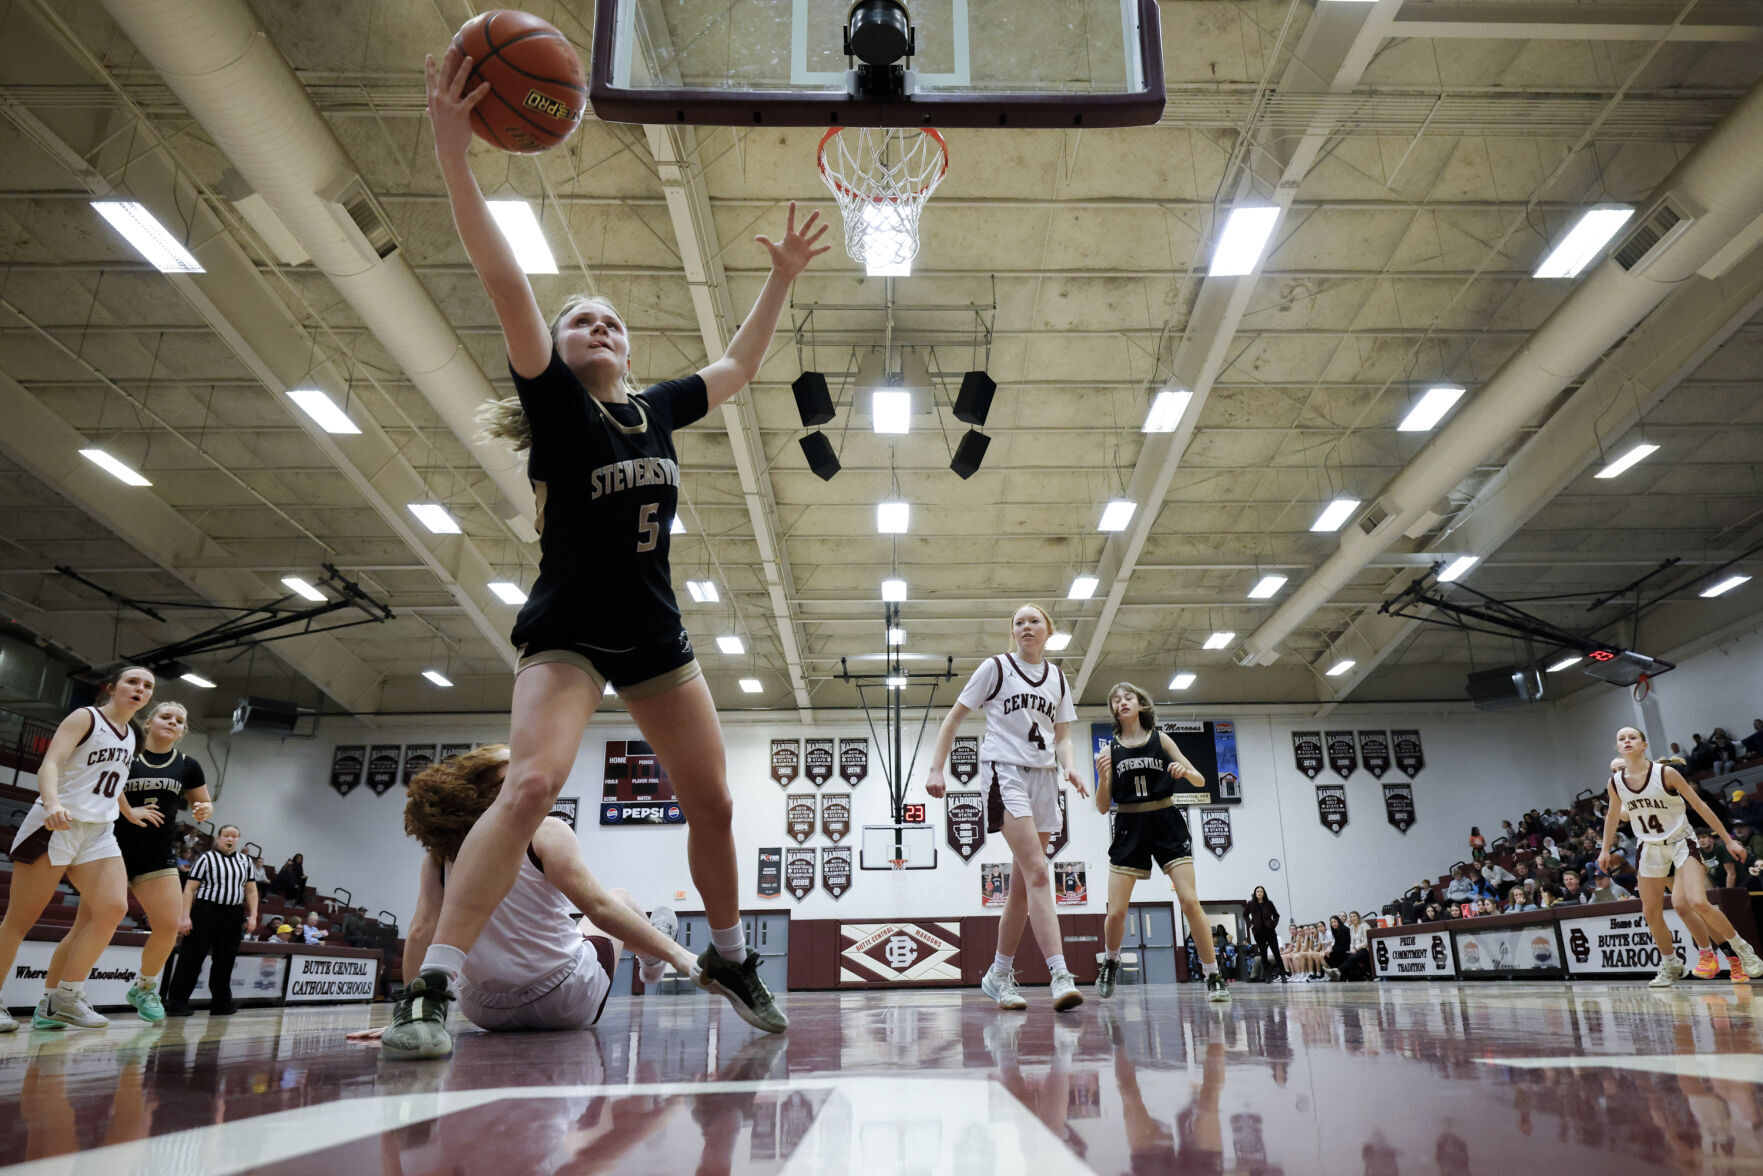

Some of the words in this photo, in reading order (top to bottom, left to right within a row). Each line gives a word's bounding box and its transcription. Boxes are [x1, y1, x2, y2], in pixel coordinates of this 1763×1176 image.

[591, 457, 678, 500] STEVENSVI
[636, 502, 660, 552] 5
[1164, 722, 1201, 731] Maroons
[1028, 721, 1046, 750] 4
[87, 747, 132, 767] CENTRA
[1116, 757, 1164, 777] STEVENSVILLE
[92, 770, 120, 798] 10
[1134, 776, 1148, 796] 11
[552, 804, 576, 819] ROONS
[948, 797, 982, 812] MAROONS
[1628, 798, 1668, 812] ENTRAL
[622, 808, 664, 818] PEPSI
[906, 806, 923, 820] 23
[1638, 815, 1665, 833] 14
[1610, 918, 1632, 929] Home
[1634, 915, 1642, 927] of
[856, 941, 872, 952] BUTTE
[872, 927, 894, 942] CENTRAL
[914, 930, 942, 948] MAROONS
[1400, 936, 1416, 946] PRIDE
[1598, 933, 1630, 947] BUTTE
[1632, 930, 1682, 946] CENL
[1393, 949, 1428, 959] COMMITMENT
[1601, 946, 1687, 968] MAROOS
[16, 966, 48, 979] Where
[302, 960, 330, 975] BUTTE
[332, 960, 368, 976] CENTRAL
[1397, 962, 1426, 972] TRADITION
[88, 968, 136, 982] Knowledge
[292, 981, 335, 996] CATHOLIC
[335, 981, 372, 996] SCHOOLS
